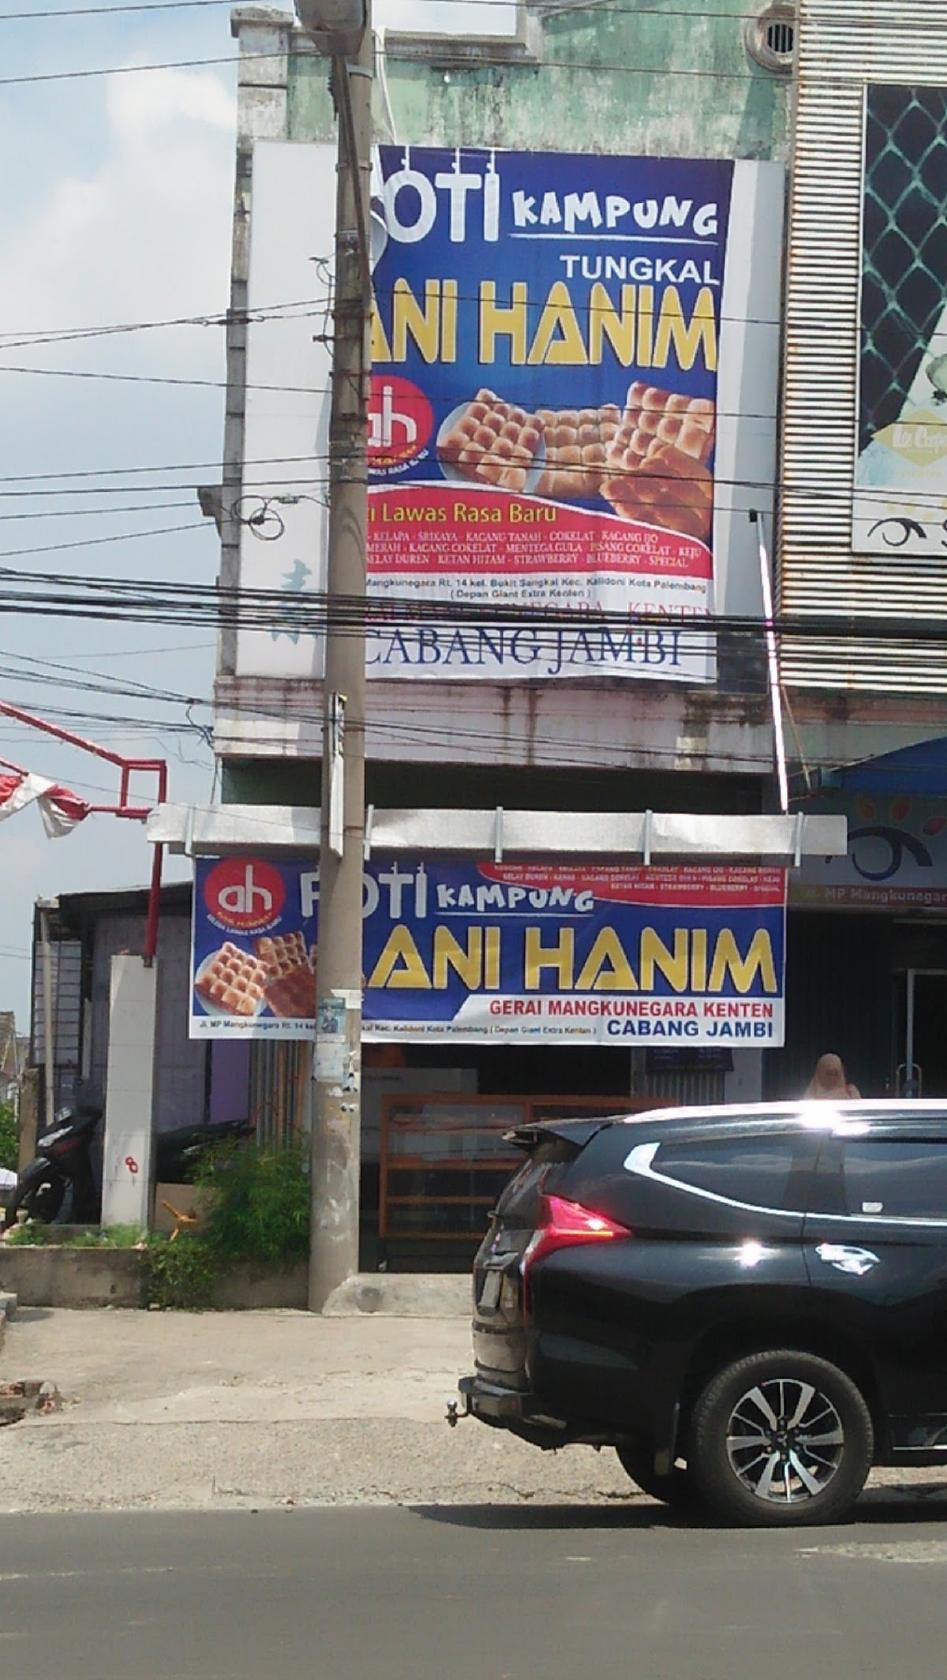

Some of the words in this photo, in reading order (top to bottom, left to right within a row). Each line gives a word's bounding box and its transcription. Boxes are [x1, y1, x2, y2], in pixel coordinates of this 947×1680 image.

[382, 168, 500, 243] OTI
[512, 190, 718, 236] KAMPUNG
[560, 255, 720, 285] TUNGKAL
[479, 280, 718, 371] HANIM
[382, 503, 447, 522] Lawas
[454, 503, 502, 522] Rasa
[509, 503, 557, 524] Baru
[373, 532, 410, 542] KELAPA
[417, 532, 458, 542] SRIKAYA
[466, 532, 507, 542] KACANG
[508, 533, 541, 542] TANAH
[549, 531, 595, 541] COKELAT
[601, 531, 642, 542] KACANG
[409, 543, 450, 553] KACANG
[452, 543, 498, 553] COKELAT
[625, 543, 671, 556] COKELAT
[472, 554, 506, 564] HITAM
[514, 554, 579, 565] STRAWBERRY
[586, 553, 642, 566] BLUEBERRY
[649, 556, 689, 569] SPECIAL
[456, 578, 468, 587] 14
[490, 578, 517, 587] Bukit
[628, 578, 651, 588] Kota
[653, 579, 707, 594] Palembang
[521, 590, 546, 599] Extra
[547, 626, 681, 675] JAMBI
[437, 884, 595, 912] KAMPUNG
[366, 924, 500, 991] ANI
[524, 925, 778, 994] HANIM
[489, 1000, 542, 1016] GERAI
[547, 1000, 698, 1018] MANGKUNEGARA
[703, 1001, 773, 1018] KENTEN
[606, 1020, 700, 1037] CABANG
[705, 1021, 773, 1038] JAMBI
